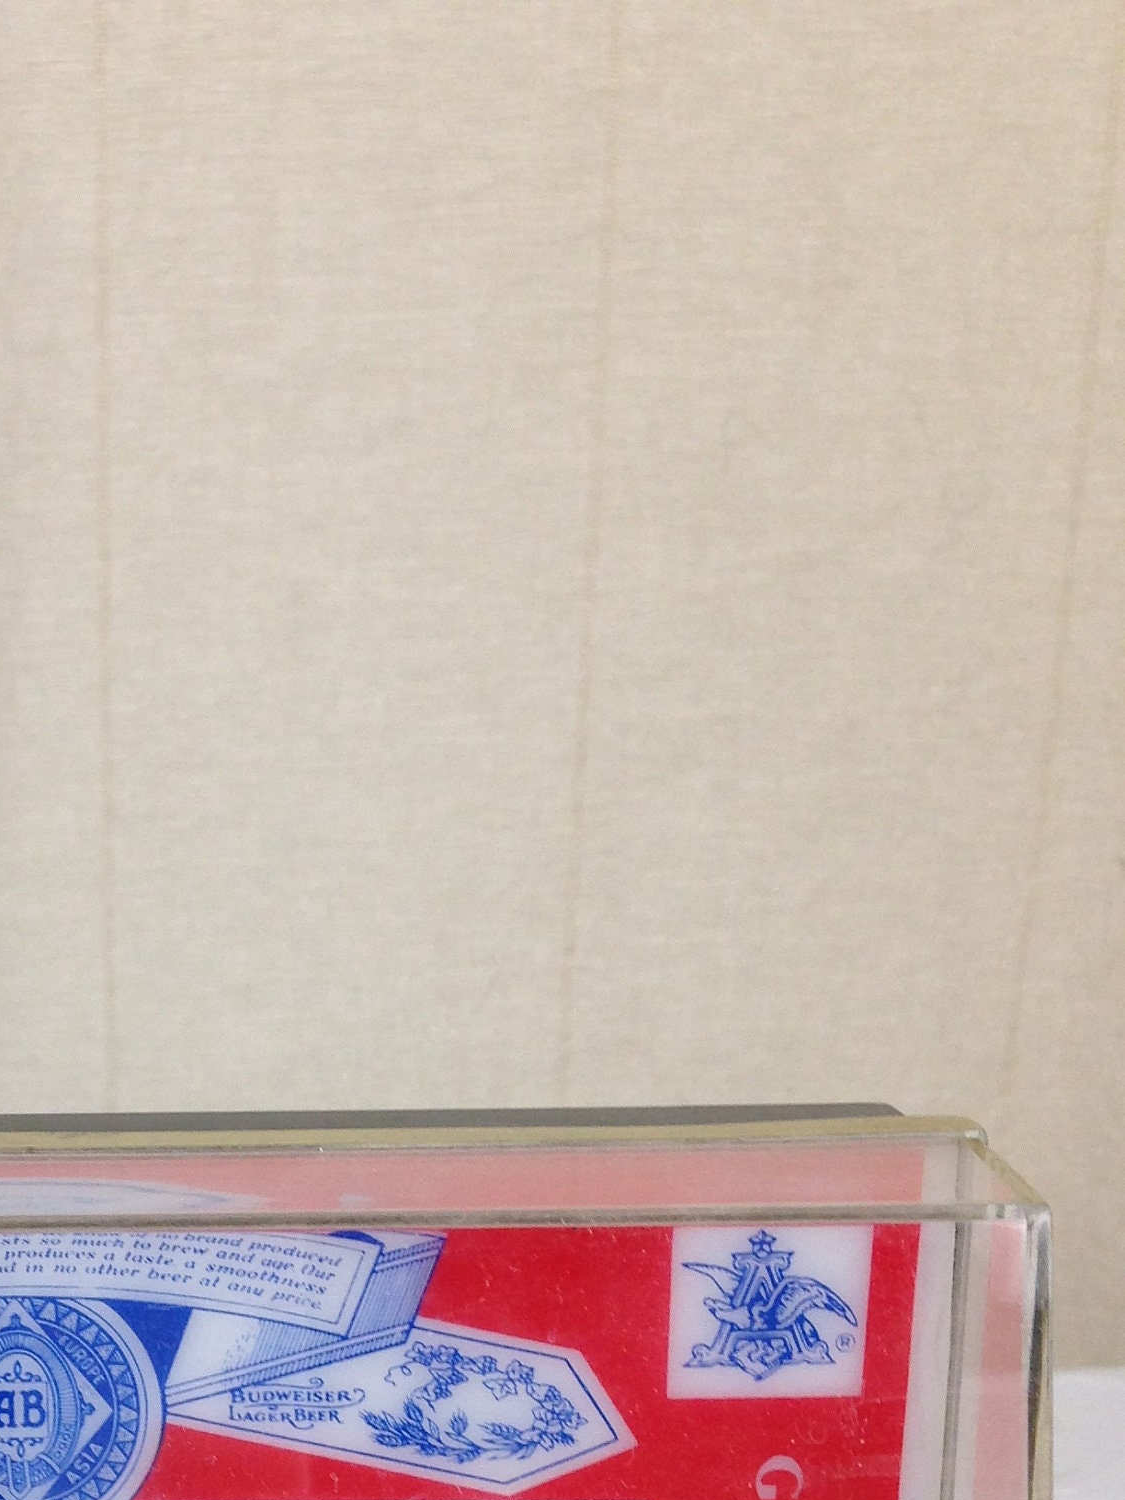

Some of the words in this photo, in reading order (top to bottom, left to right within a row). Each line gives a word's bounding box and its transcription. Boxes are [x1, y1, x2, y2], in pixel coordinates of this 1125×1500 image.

[39, 1237, 62, 1246] so
[70, 1238, 126, 1249] much
[132, 1239, 152, 1250] to
[157, 1241, 211, 1256] brew
[215, 1249, 257, 1264] and
[247, 1240, 344, 1268] produced
[4, 1247, 97, 1261] produces
[184, 1259, 196, 1270] a
[205, 1262, 328, 1295] smoothness
[25, 1263, 44, 1274] in
[54, 1263, 78, 1274] no
[84, 1263, 141, 1278] other
[146, 1267, 193, 1284] beer
[198, 1276, 221, 1288] at
[226, 1281, 265, 1297] any
[55, 1332, 107, 1386] EUROPE
[229, 1387, 353, 1404] BUDWEISER
[65, 1442, 104, 1486] ASIA
